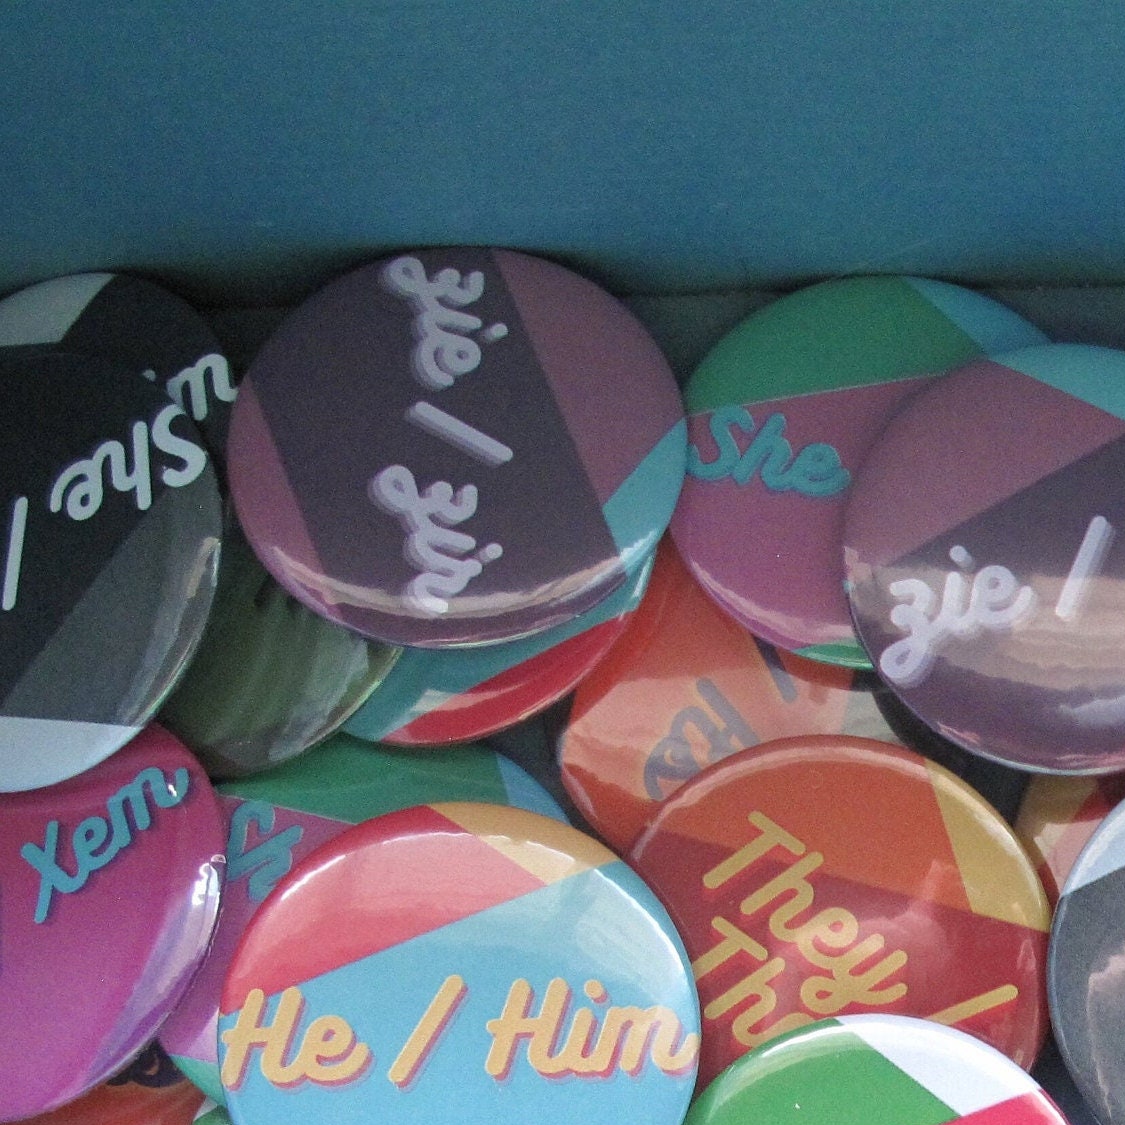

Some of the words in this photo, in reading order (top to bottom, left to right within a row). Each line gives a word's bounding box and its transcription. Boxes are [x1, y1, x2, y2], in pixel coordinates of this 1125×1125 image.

[378, 256, 508, 391] zie
[50, 404, 207, 521] She
[686, 404, 851, 497] She
[368, 464, 504, 614] zir
[880, 547, 1038, 688] zie
[21, 766, 191, 926] Xem
[703, 810, 909, 1014] They
[219, 987, 373, 1093] He
[485, 978, 702, 1084] Him
